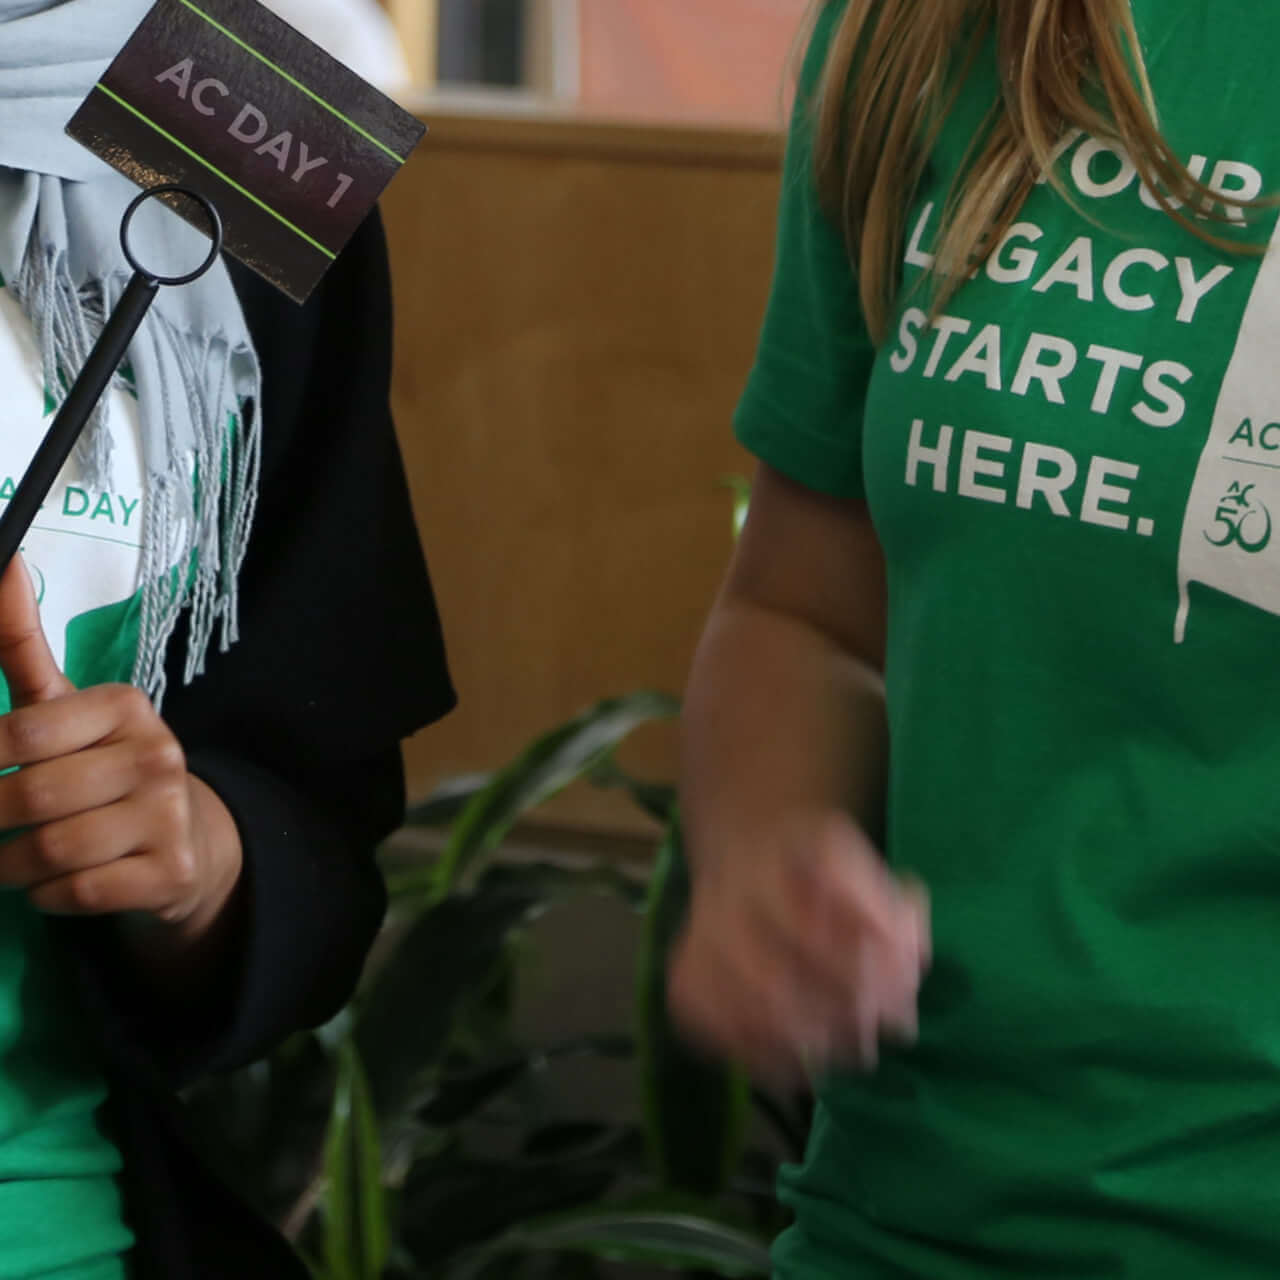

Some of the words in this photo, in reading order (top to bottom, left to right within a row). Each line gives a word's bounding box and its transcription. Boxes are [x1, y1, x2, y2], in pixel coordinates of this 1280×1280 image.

[155, 57, 229, 116] AC
[227, 103, 328, 183] DAY
[326, 172, 354, 209] 1
[889, 307, 1194, 428] STARTS
[61, 485, 139, 527] DAY
[904, 419, 1157, 537] HERE.
[1202, 499, 1272, 554] 50
